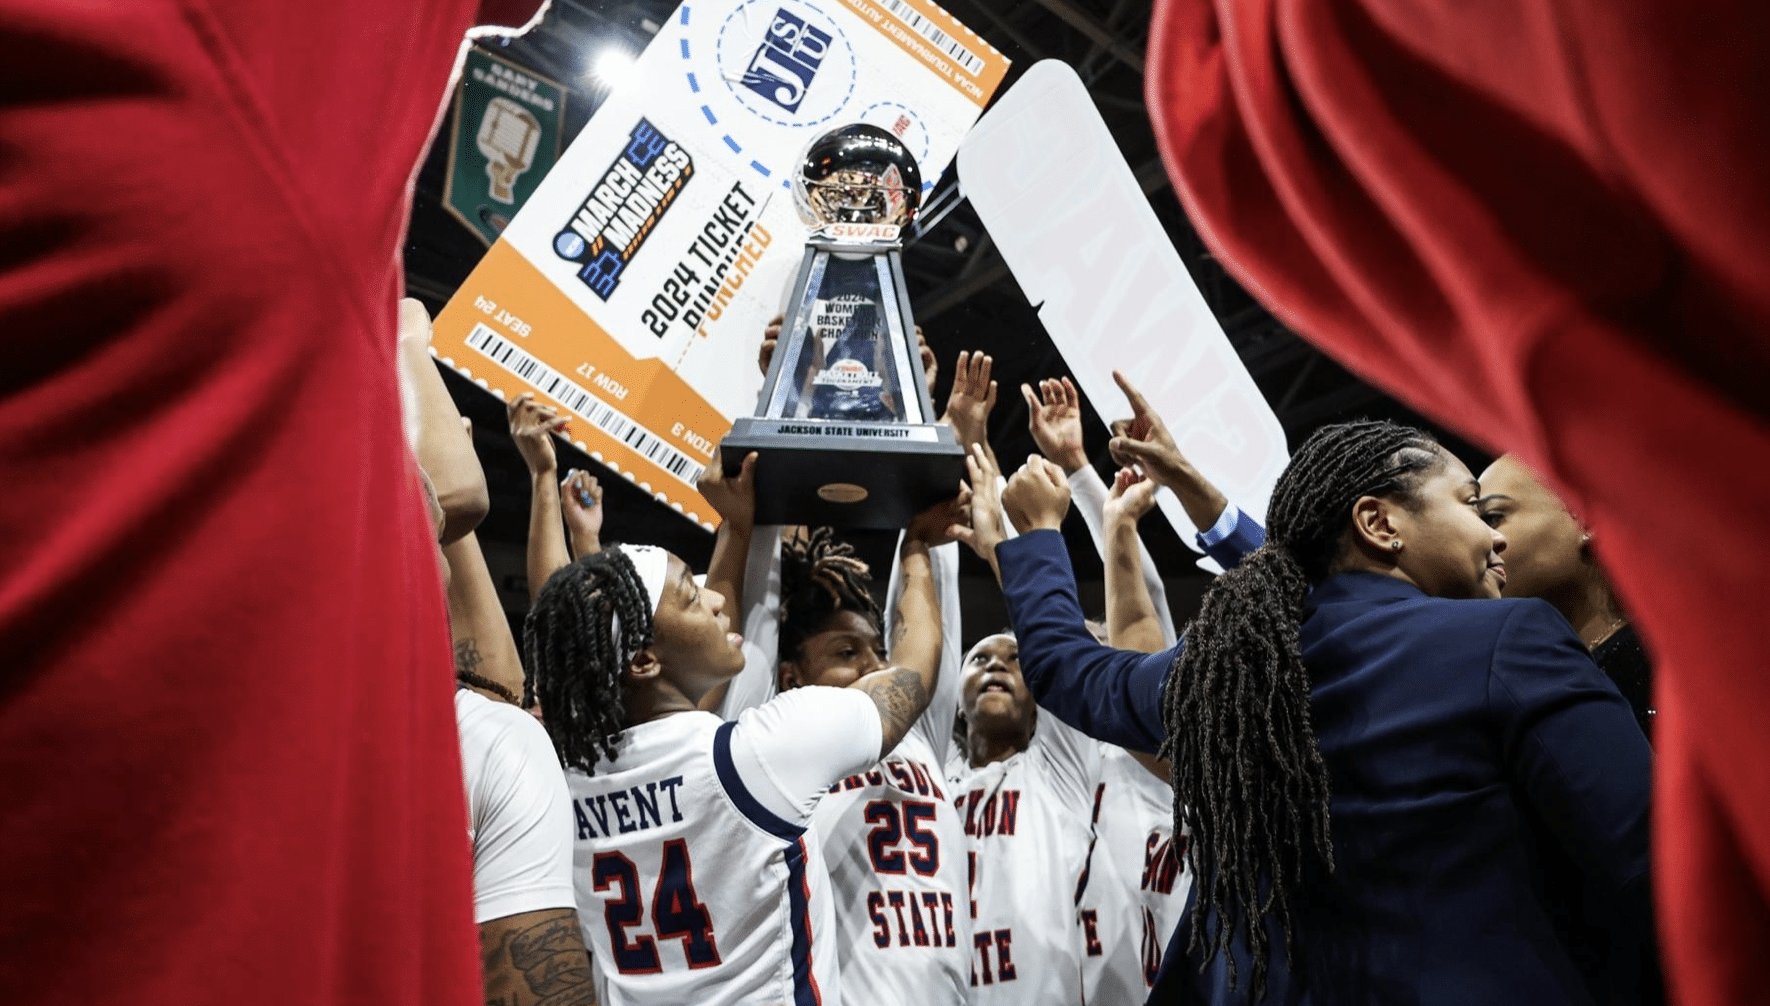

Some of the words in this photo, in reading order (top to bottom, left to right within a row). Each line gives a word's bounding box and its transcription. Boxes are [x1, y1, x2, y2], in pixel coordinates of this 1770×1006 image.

[875, 19, 954, 77] TOURNAMENT
[570, 156, 643, 244] MARCH
[602, 142, 691, 252] MADNESS
[641, 262, 702, 338] 2024
[689, 181, 756, 270] TICKET
[831, 225, 896, 237] SWAC
[473, 293, 496, 316] 24
[495, 310, 533, 338] SEAT
[598, 377, 629, 401] ROW
[777, 424, 822, 436] JACKSON
[825, 426, 853, 437] STATE
[856, 427, 909, 439] UNIVERSITY
[573, 775, 683, 840] AVENT
[864, 800, 940, 877] 25
[592, 837, 722, 975] 24
[867, 891, 956, 949] STATE
